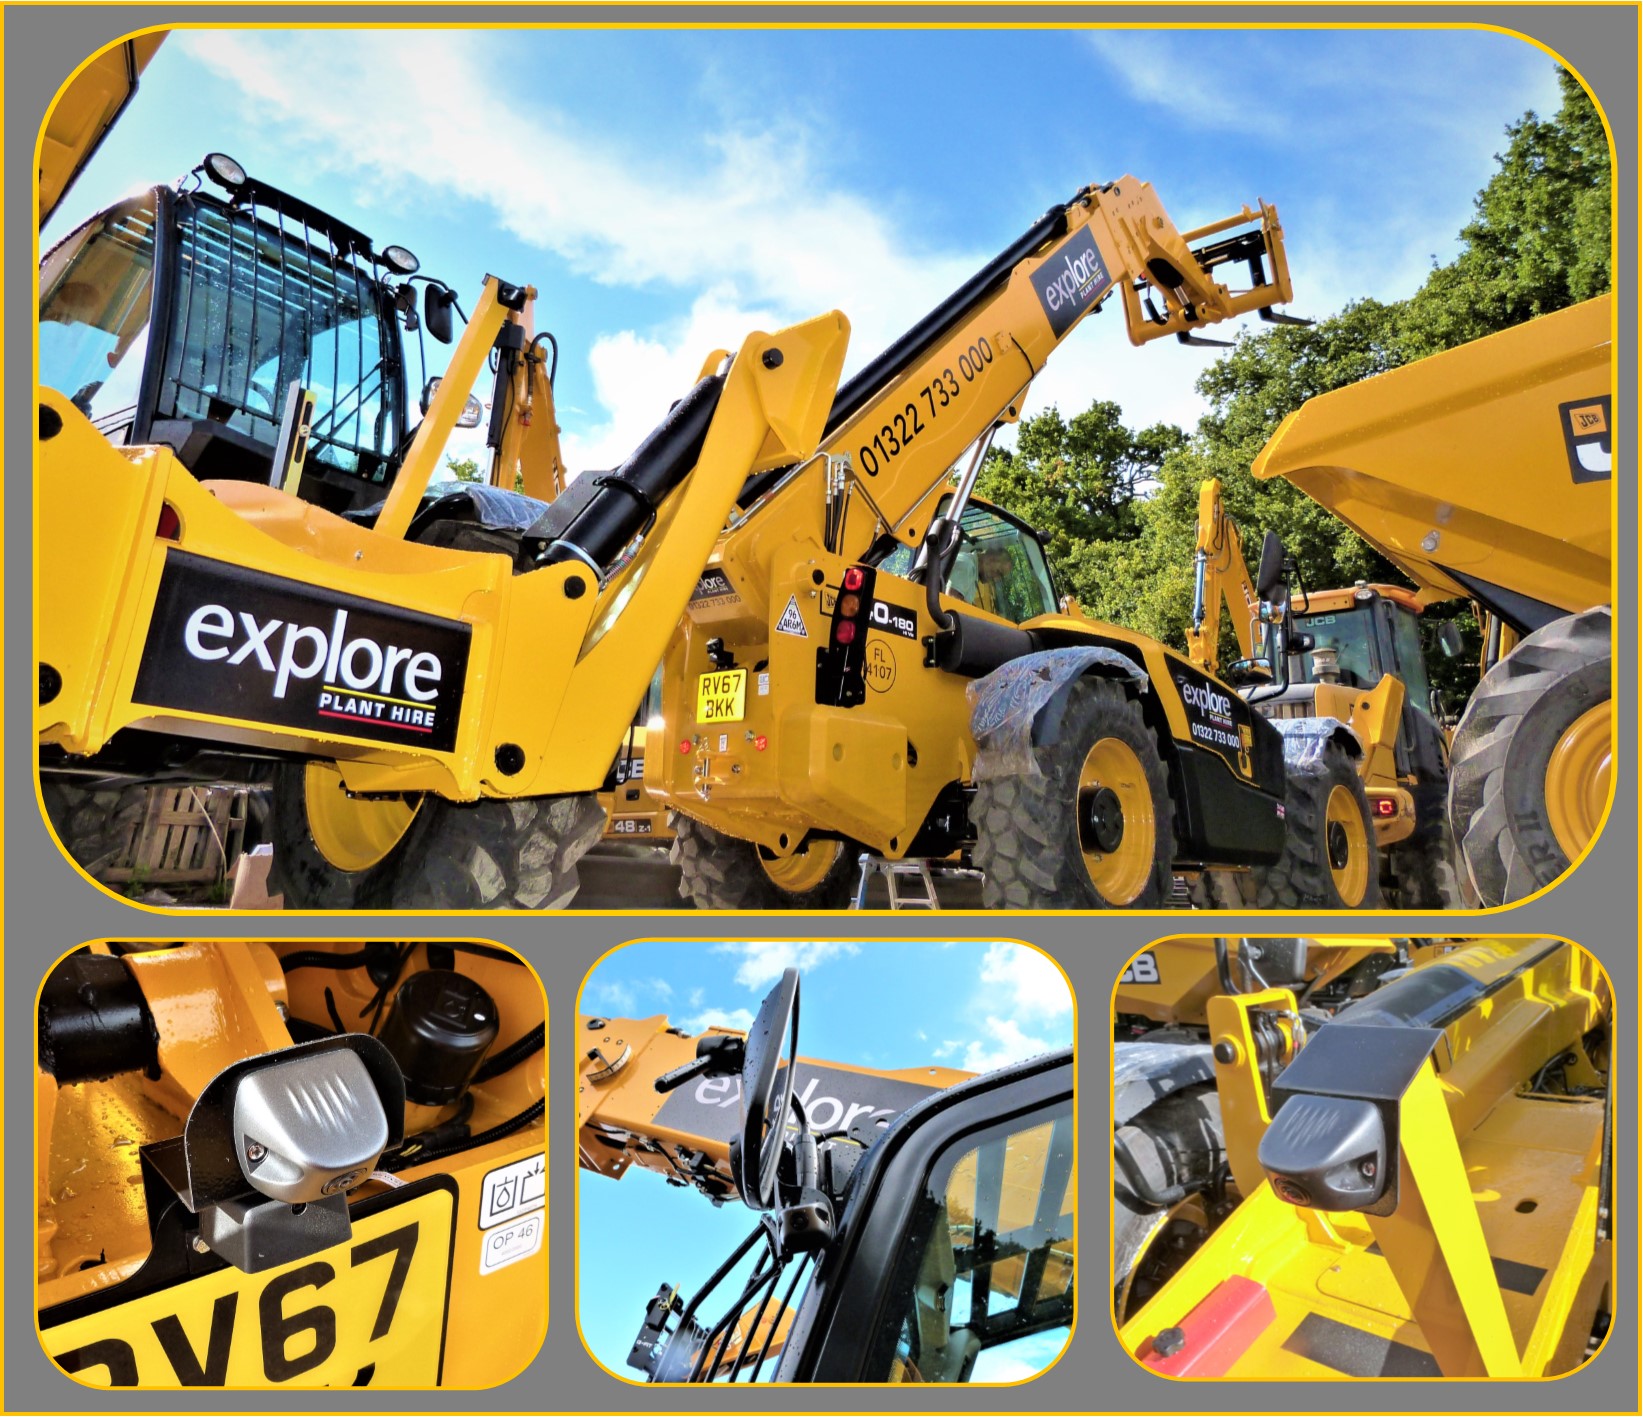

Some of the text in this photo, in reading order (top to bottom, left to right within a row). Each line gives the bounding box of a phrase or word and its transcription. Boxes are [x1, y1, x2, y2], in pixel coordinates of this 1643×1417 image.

[1046, 248, 1098, 311] explore
[859, 336, 993, 477] 01322 733 000
[1579, 414, 1599, 428] JCB
[696, 576, 725, 595] plore
[788, 609, 797, 620] 96
[1306, 615, 1336, 627] JCB
[184, 604, 442, 701] explore
[874, 648, 886, 663] FL
[702, 674, 742, 696] RV67
[319, 692, 435, 727] PLANT HIRE
[705, 697, 735, 718] BKK
[1183, 682, 1232, 716] explore
[1210, 714, 1222, 723] PLANT
[1192, 722, 1213, 740] 01322
[1213, 729, 1226, 744] 733
[1227, 734, 1240, 748] 000
[493, 1224, 534, 1249] OP 46
